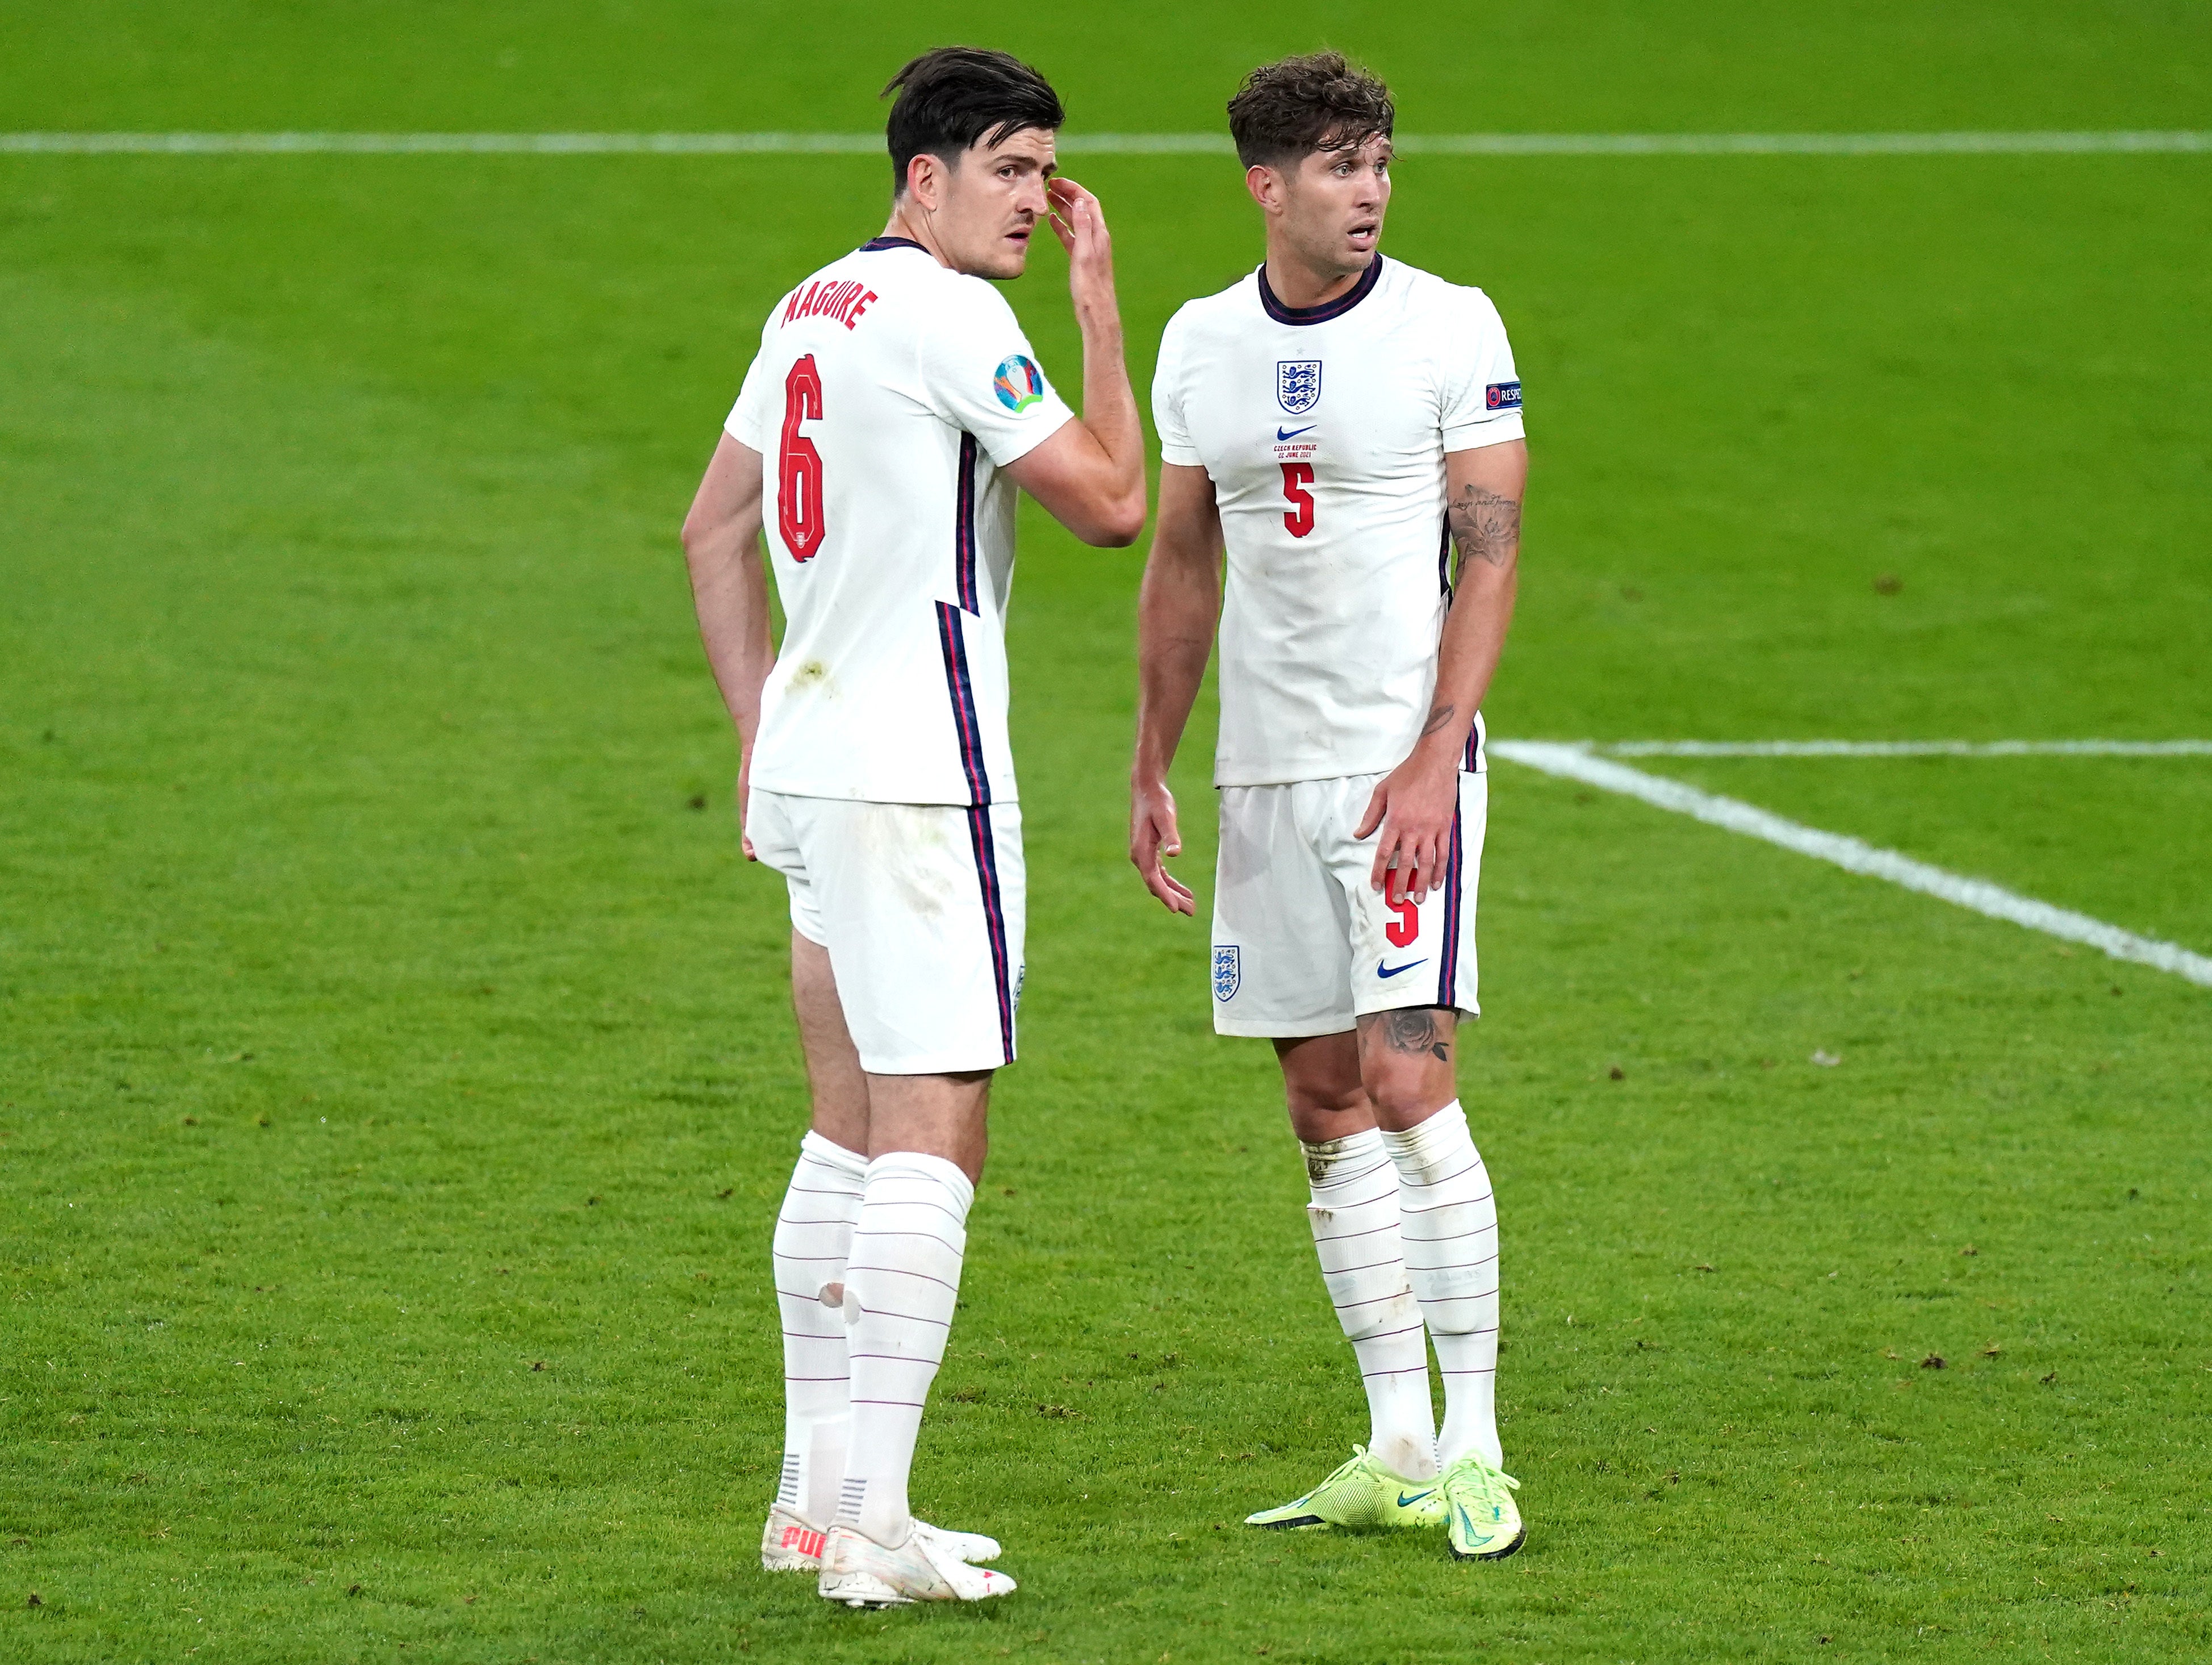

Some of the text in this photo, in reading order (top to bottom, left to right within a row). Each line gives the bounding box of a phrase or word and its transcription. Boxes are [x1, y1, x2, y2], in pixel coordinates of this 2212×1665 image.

[780, 280, 879, 331] MAGUIRE
[1501, 388, 1521, 401] RESPE
[778, 353, 825, 562] 6
[1279, 462, 1315, 538] 5
[1385, 868, 1419, 948] 5
